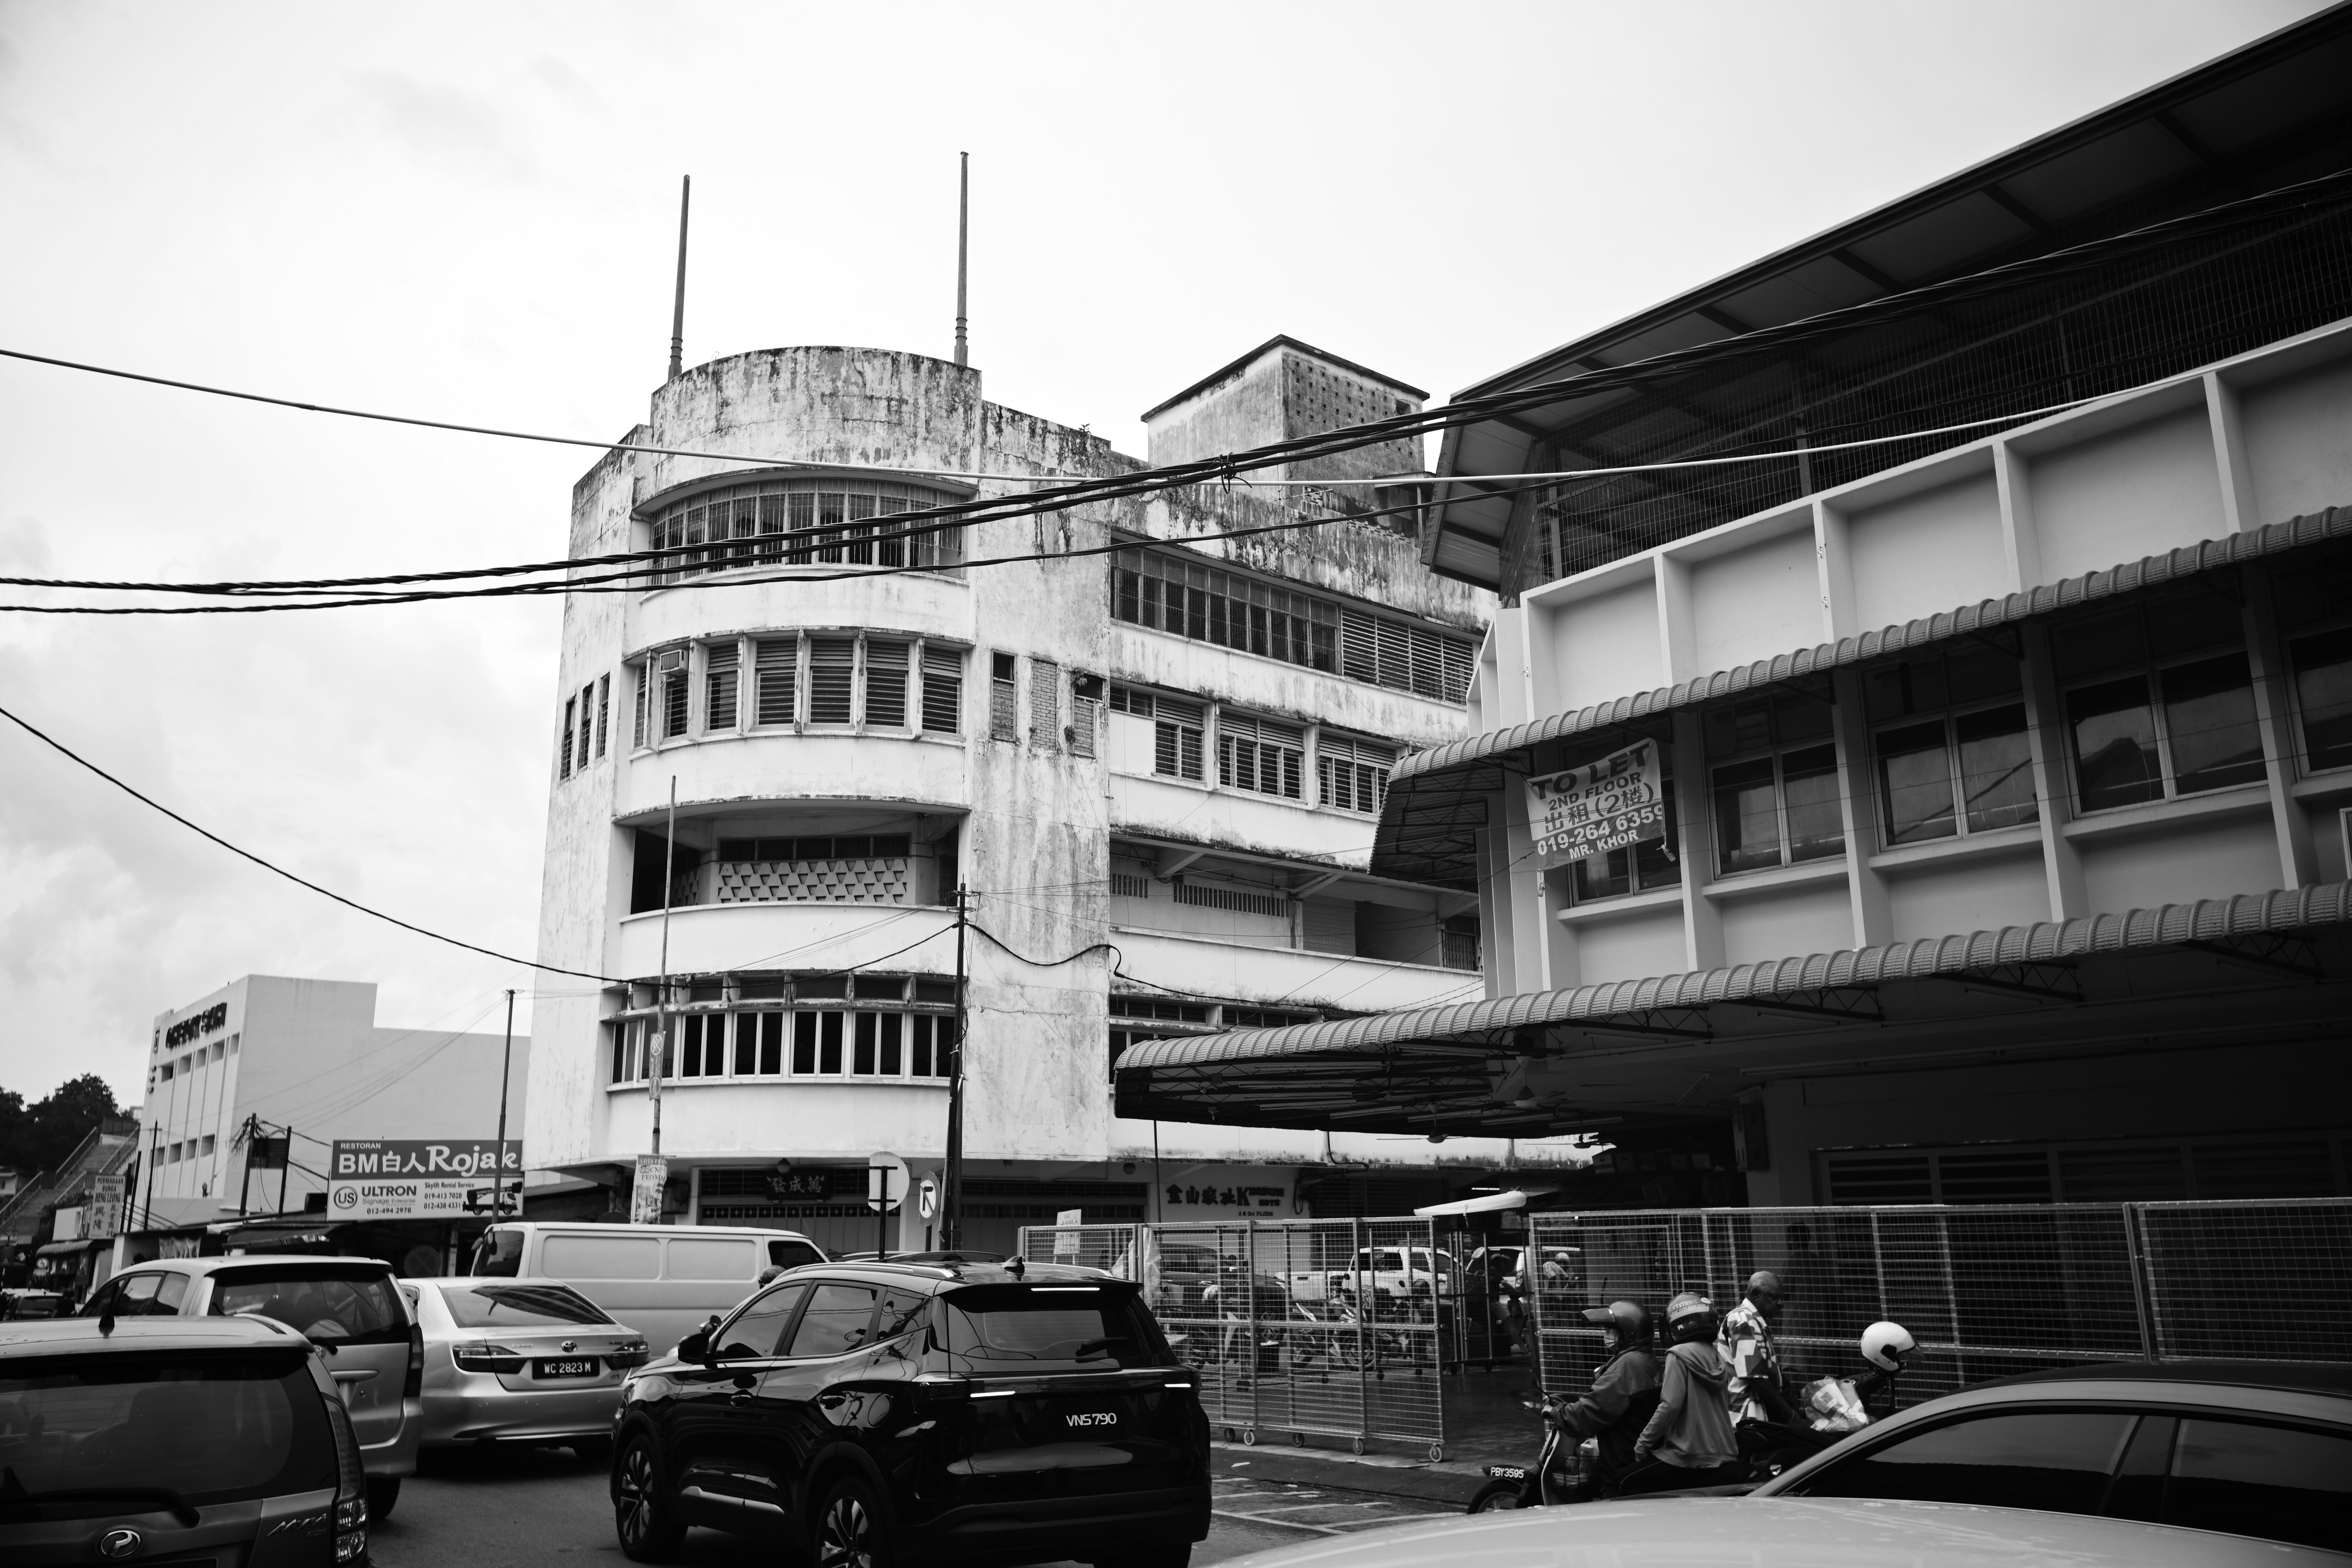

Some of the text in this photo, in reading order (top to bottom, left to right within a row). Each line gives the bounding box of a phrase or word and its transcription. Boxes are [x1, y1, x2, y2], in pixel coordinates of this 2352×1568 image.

[1531, 743, 1650, 800] TO LET
[1549, 772, 1641, 811] 2ND FLOOR
[1537, 804, 1662, 855] 019-264 6359
[1569, 830, 1639, 859] MR. KHOR
[339, 1142, 518, 1177] BM 白人 Rojak
[95, 1193, 120, 1202] HENG LEONG
[338, 1191, 355, 1204] US
[362, 1185, 417, 1197] ULTRON
[544, 1362, 591, 1374] WC 2823 M
[1066, 1413, 1117, 1426] VNS 790
[1491, 1467, 1524, 1478] PBY3595
